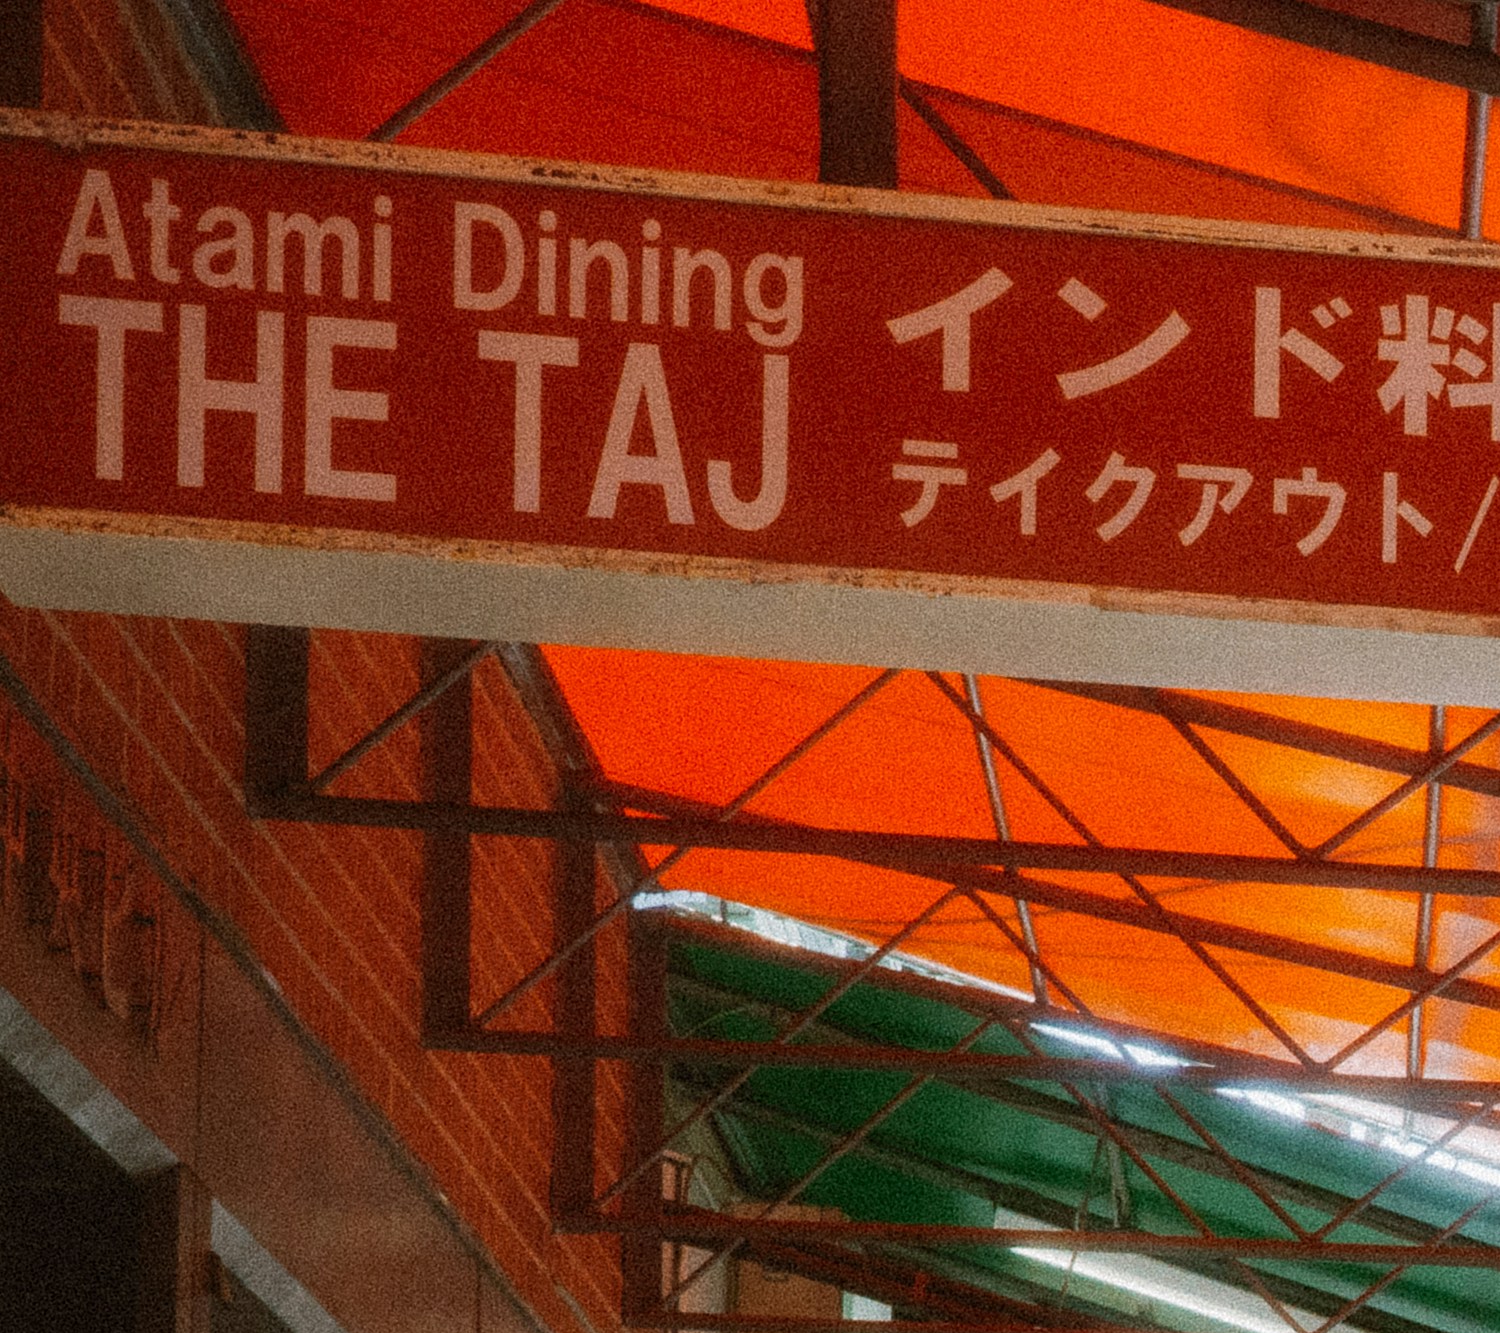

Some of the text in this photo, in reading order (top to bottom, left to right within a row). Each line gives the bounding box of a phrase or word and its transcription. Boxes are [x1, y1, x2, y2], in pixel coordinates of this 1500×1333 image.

[58, 167, 806, 346] Atami Dining
[57, 292, 790, 532] THE TAJ
